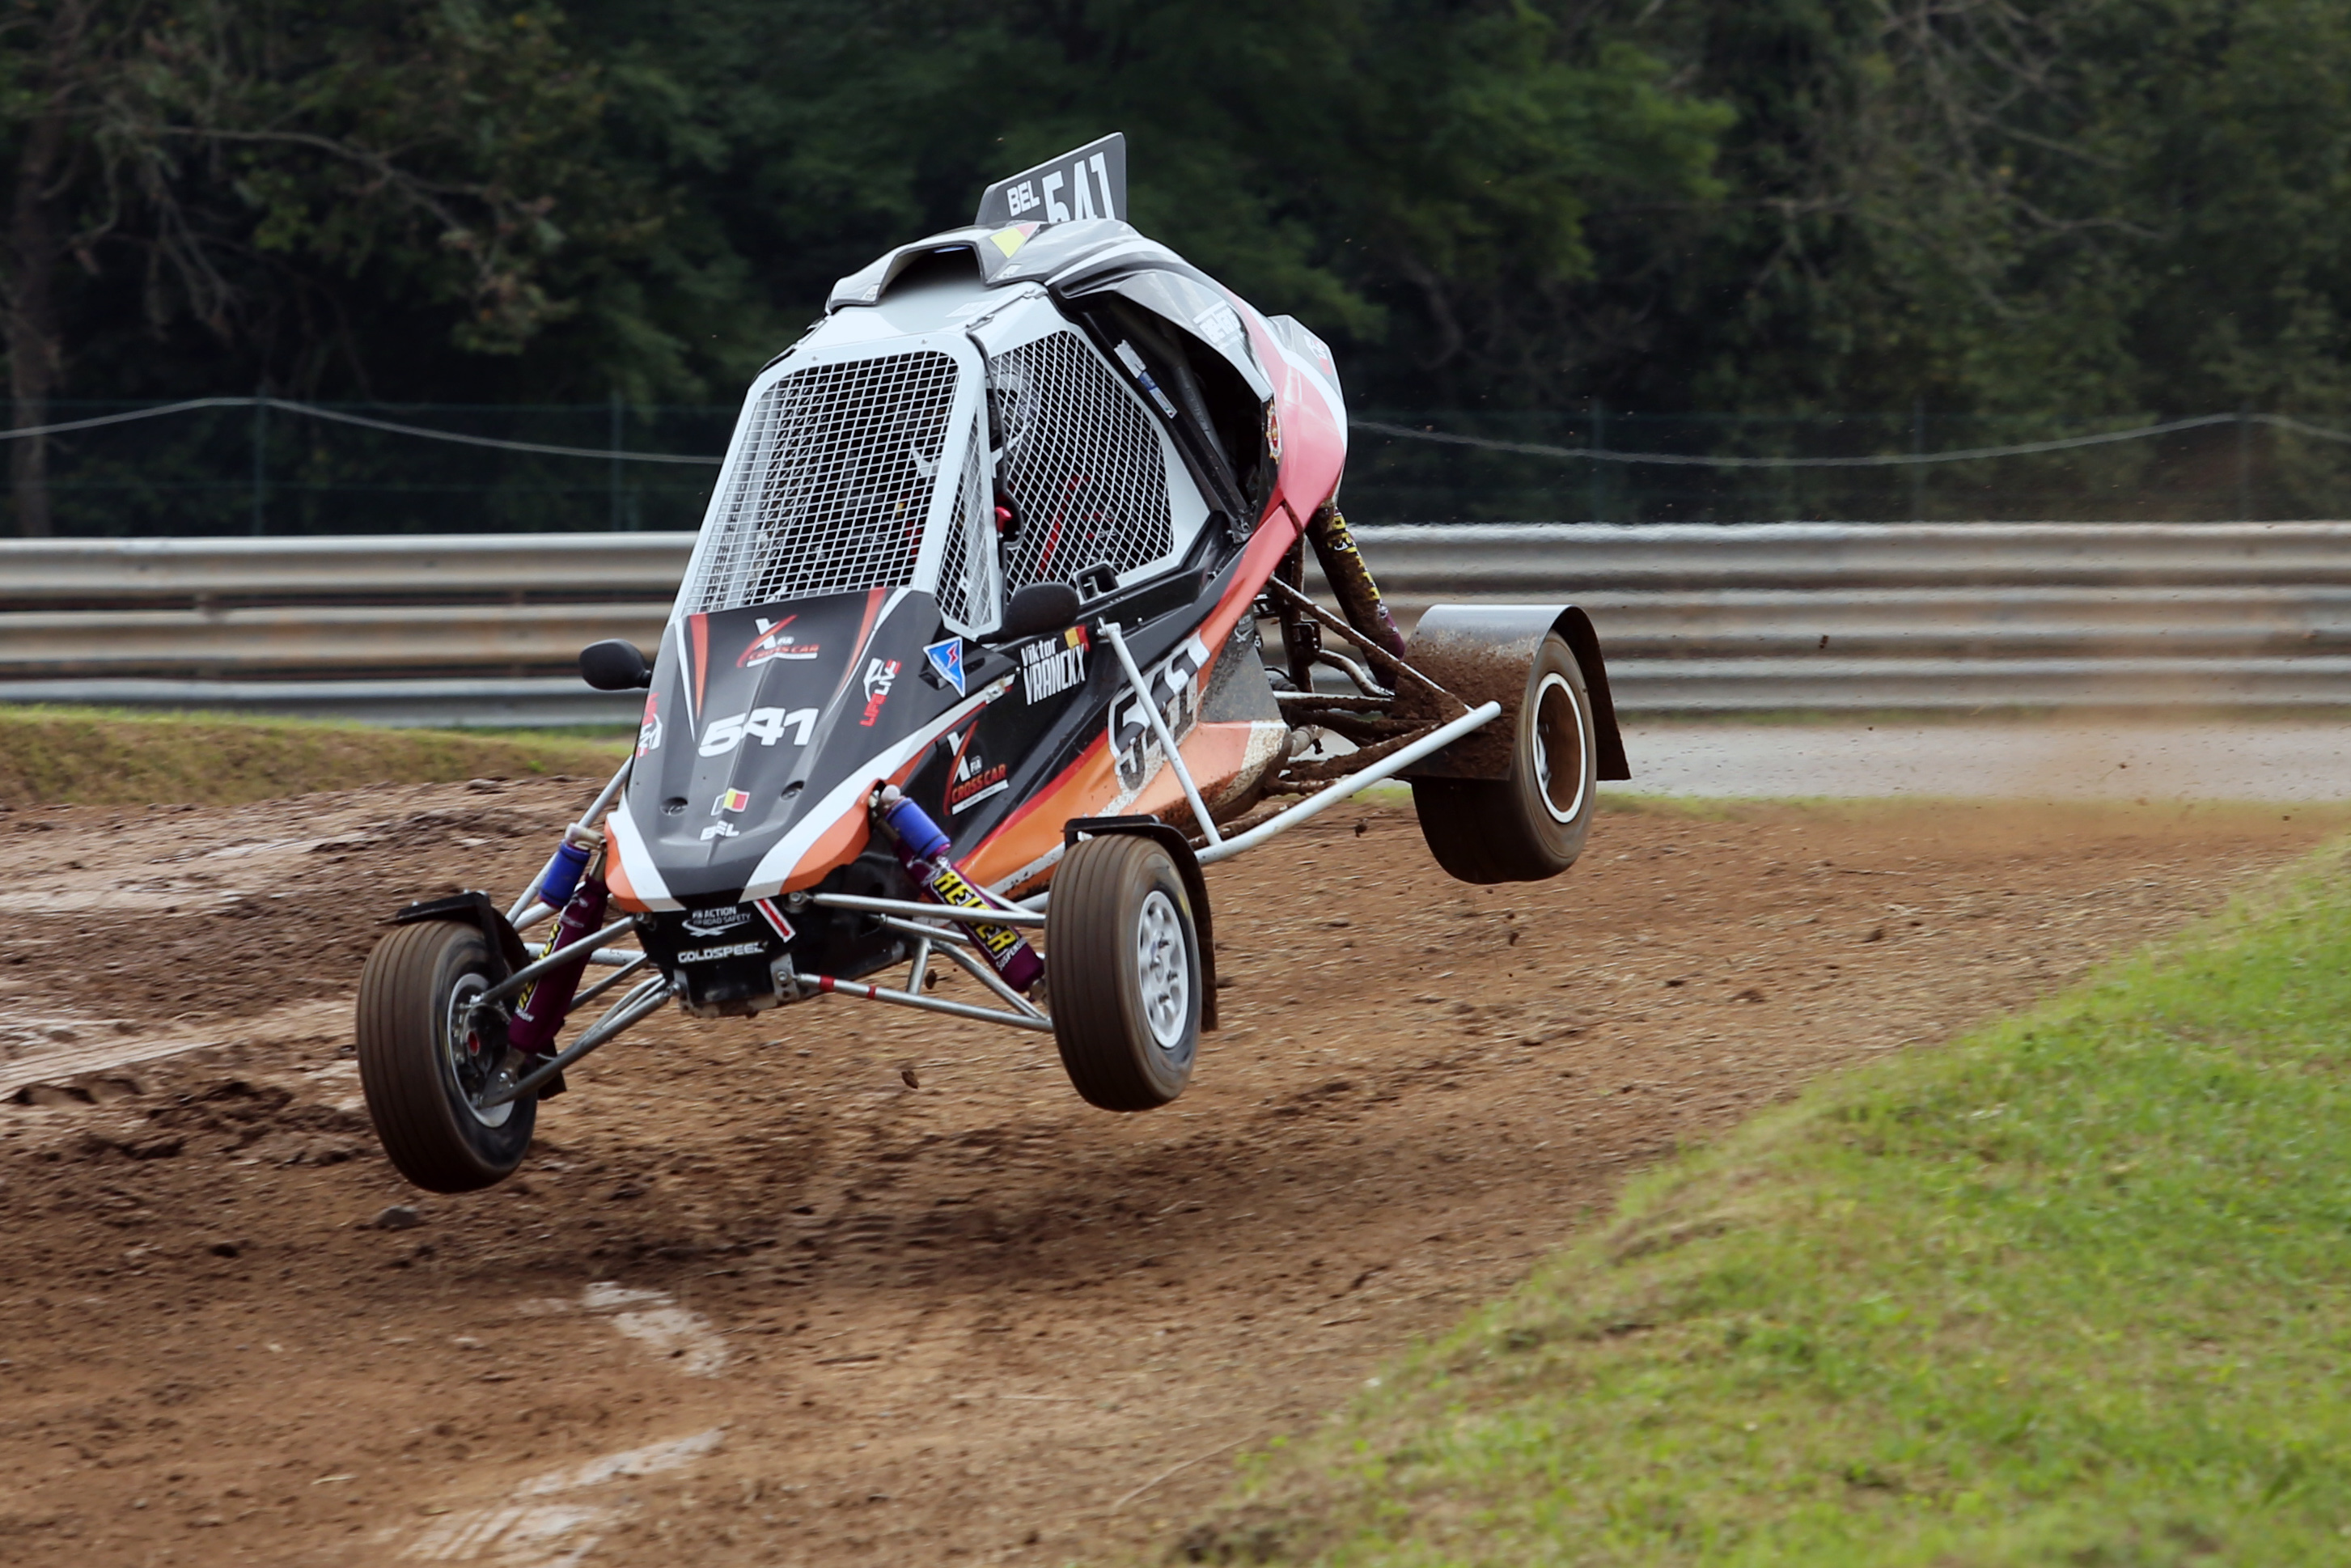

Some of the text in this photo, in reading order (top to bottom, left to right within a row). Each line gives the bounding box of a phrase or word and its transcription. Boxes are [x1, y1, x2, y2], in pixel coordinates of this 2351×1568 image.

[1007, 151, 1116, 223] BEL 541
[1020, 637, 1057, 667] Viktor
[1023, 642, 1086, 706] VRANCKX
[698, 706, 819, 757] 541
[952, 773, 984, 803] CROSS
[984, 763, 1007, 786] CAR
[700, 820, 739, 841] BEL
[704, 905, 737, 919] ACTION
[723, 913, 752, 924] SAFETY
